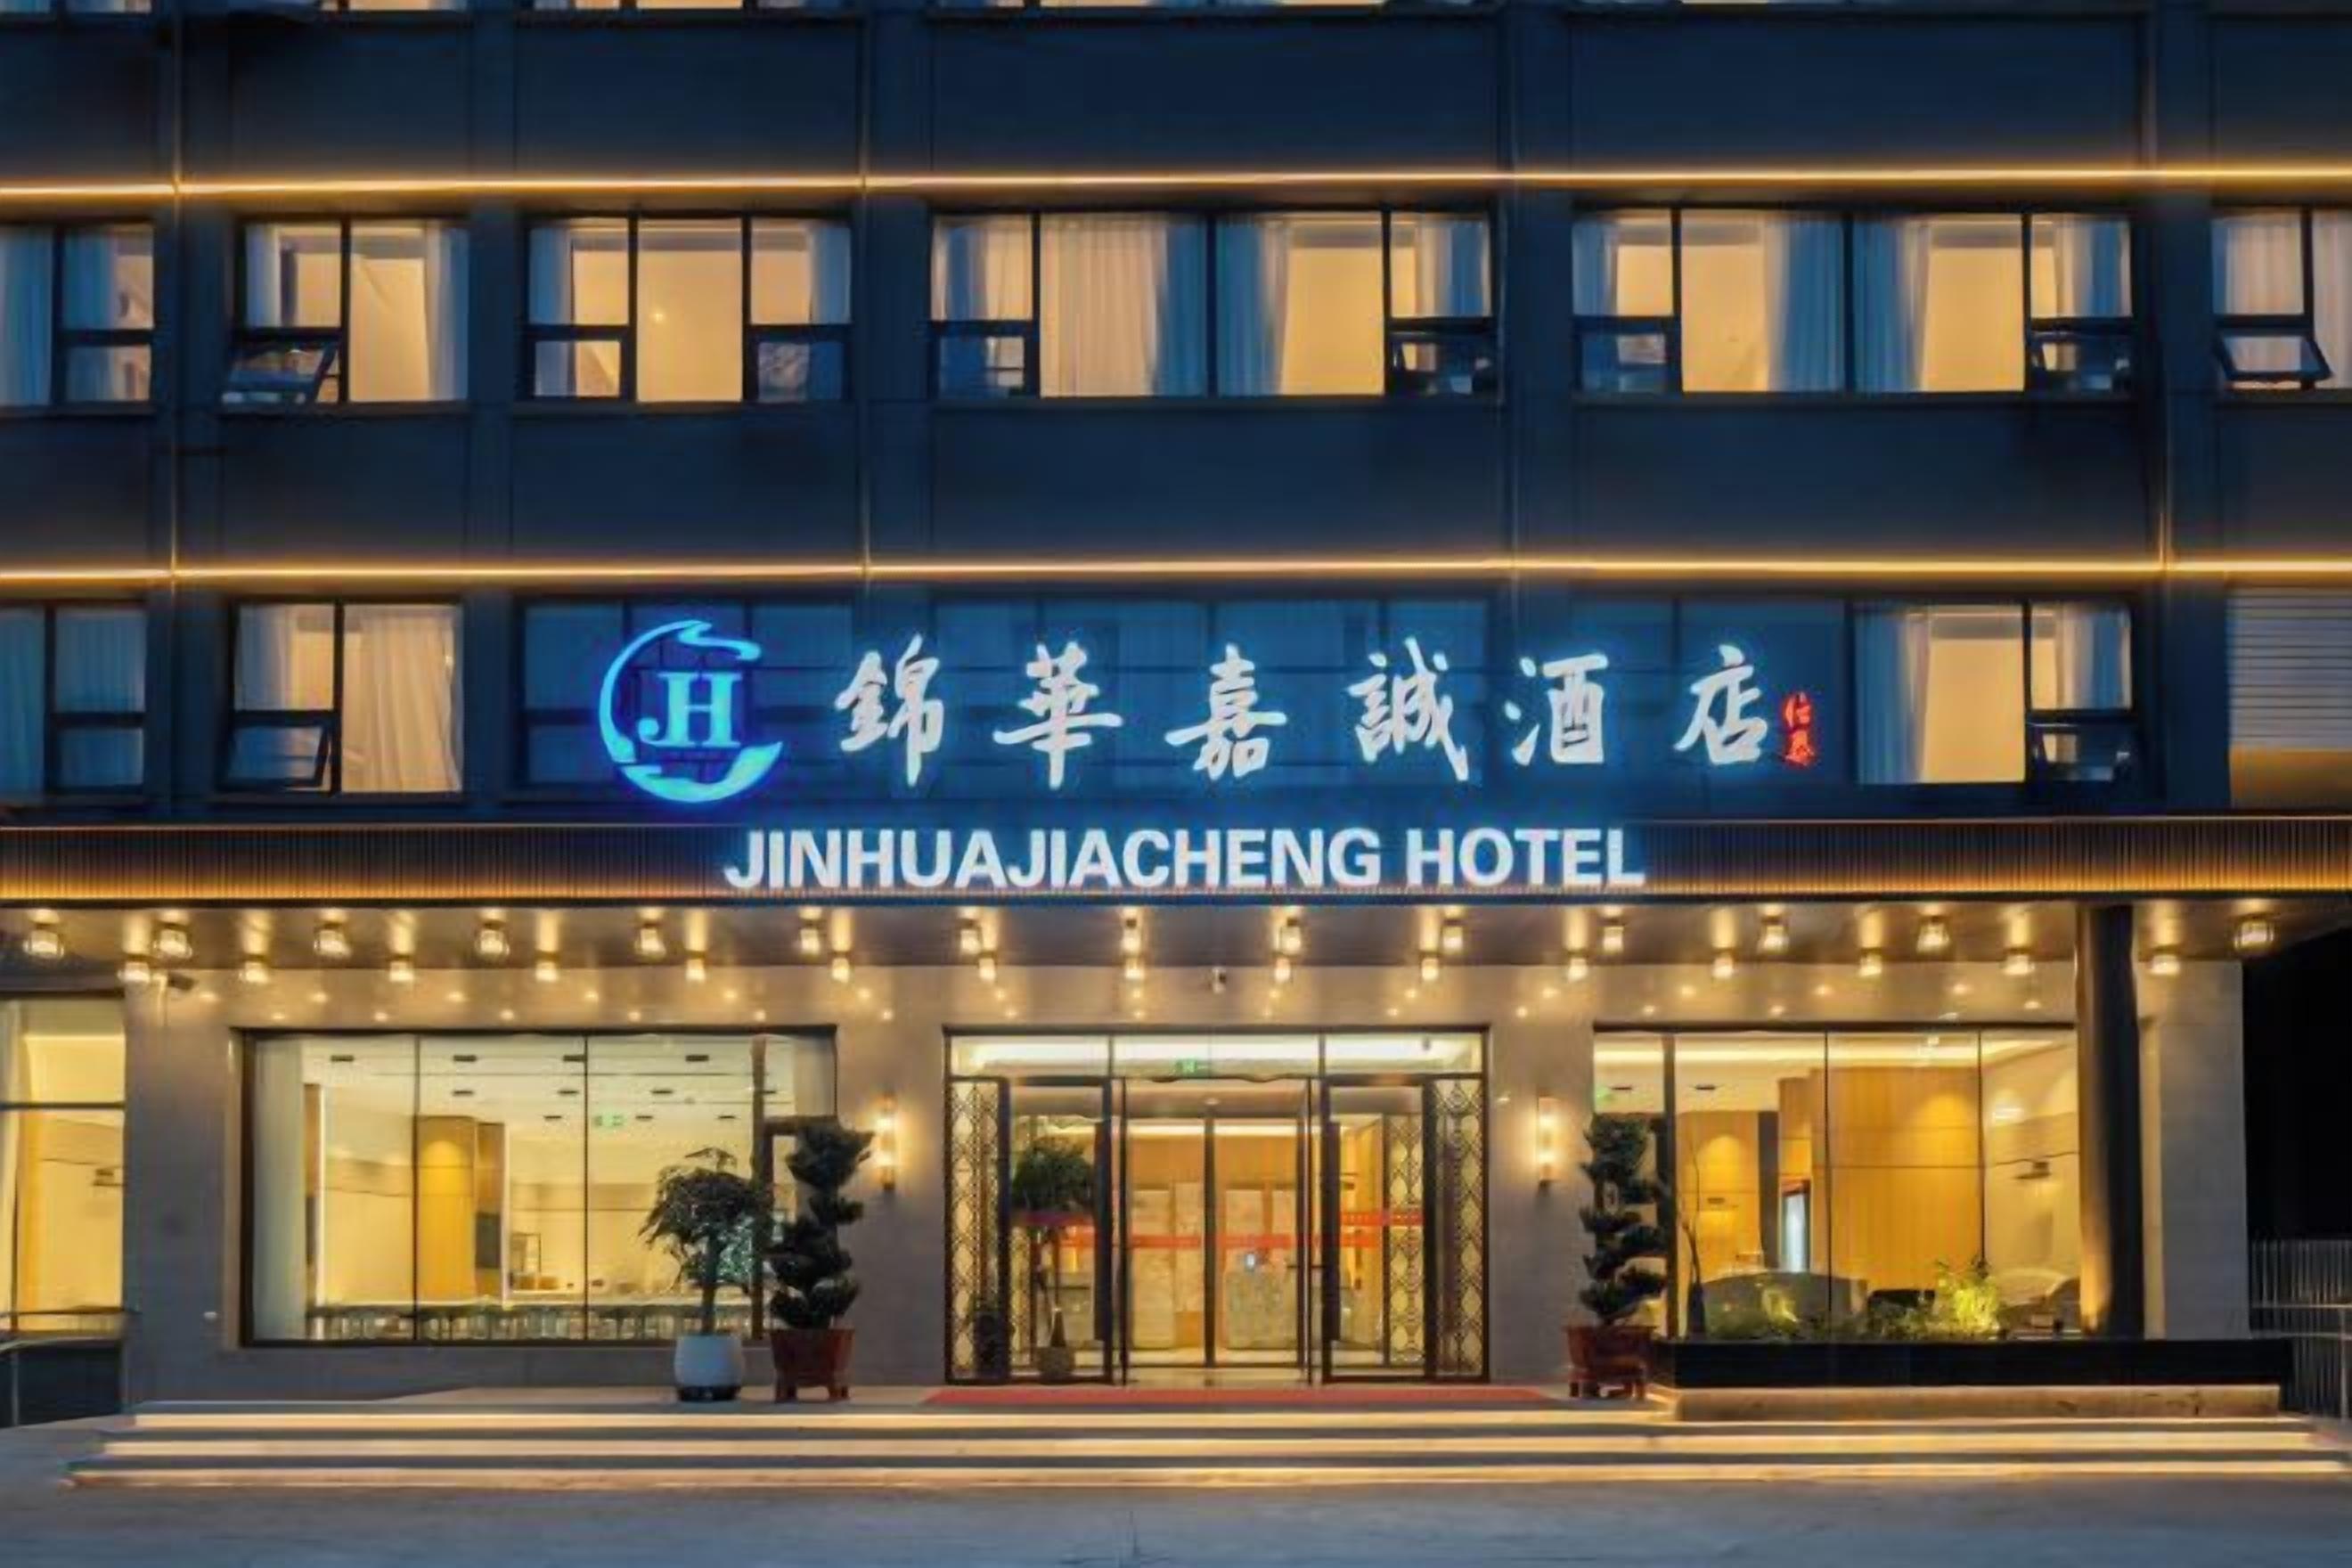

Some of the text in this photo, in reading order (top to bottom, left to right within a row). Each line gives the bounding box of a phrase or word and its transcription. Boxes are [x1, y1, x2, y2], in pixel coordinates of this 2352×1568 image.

[835, 633, 1768, 787] 錦華嘉誠酒店
[723, 828, 1646, 889] JINHUAJIACHENG HOTEL
